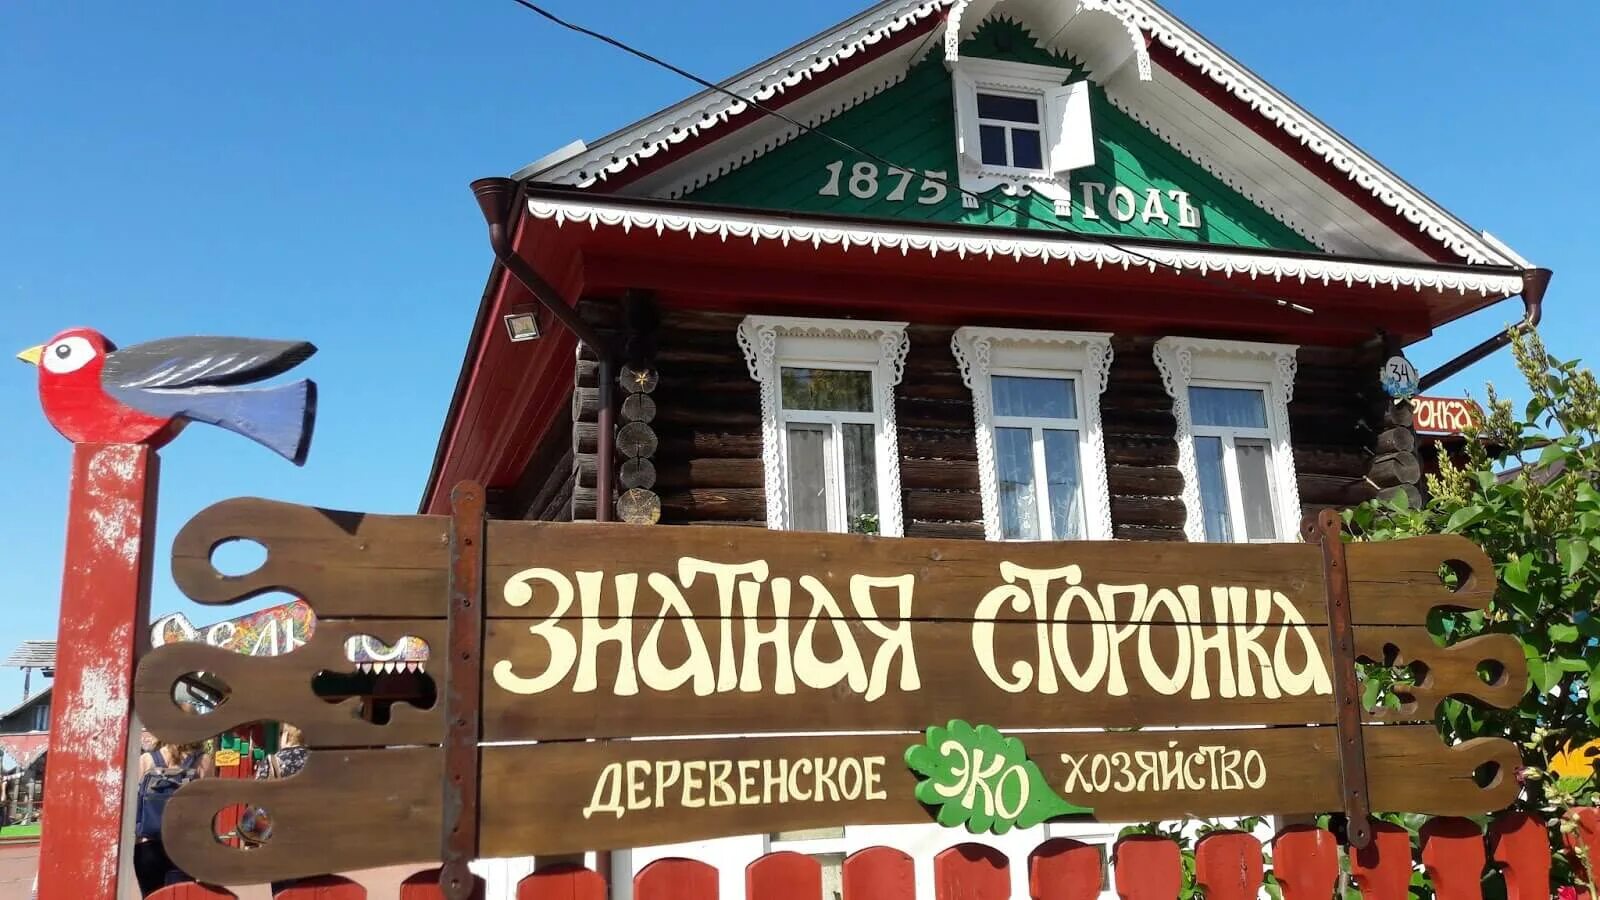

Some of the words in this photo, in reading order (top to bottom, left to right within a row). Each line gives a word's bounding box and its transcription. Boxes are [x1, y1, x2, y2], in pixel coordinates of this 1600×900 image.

[818, 160, 948, 205] 1875
[1079, 181, 1202, 229] ГОДЪ
[1390, 363, 1410, 382] 34
[493, 556, 921, 702] ЗНАТНАЯ
[972, 561, 1333, 700] СТОРОНКА
[583, 755, 887, 819] ДЕРЕВЕНСКОЕ
[934, 739, 1030, 820] ЭКО
[1060, 741, 1267, 793] ХОЗЯЙСТВО
